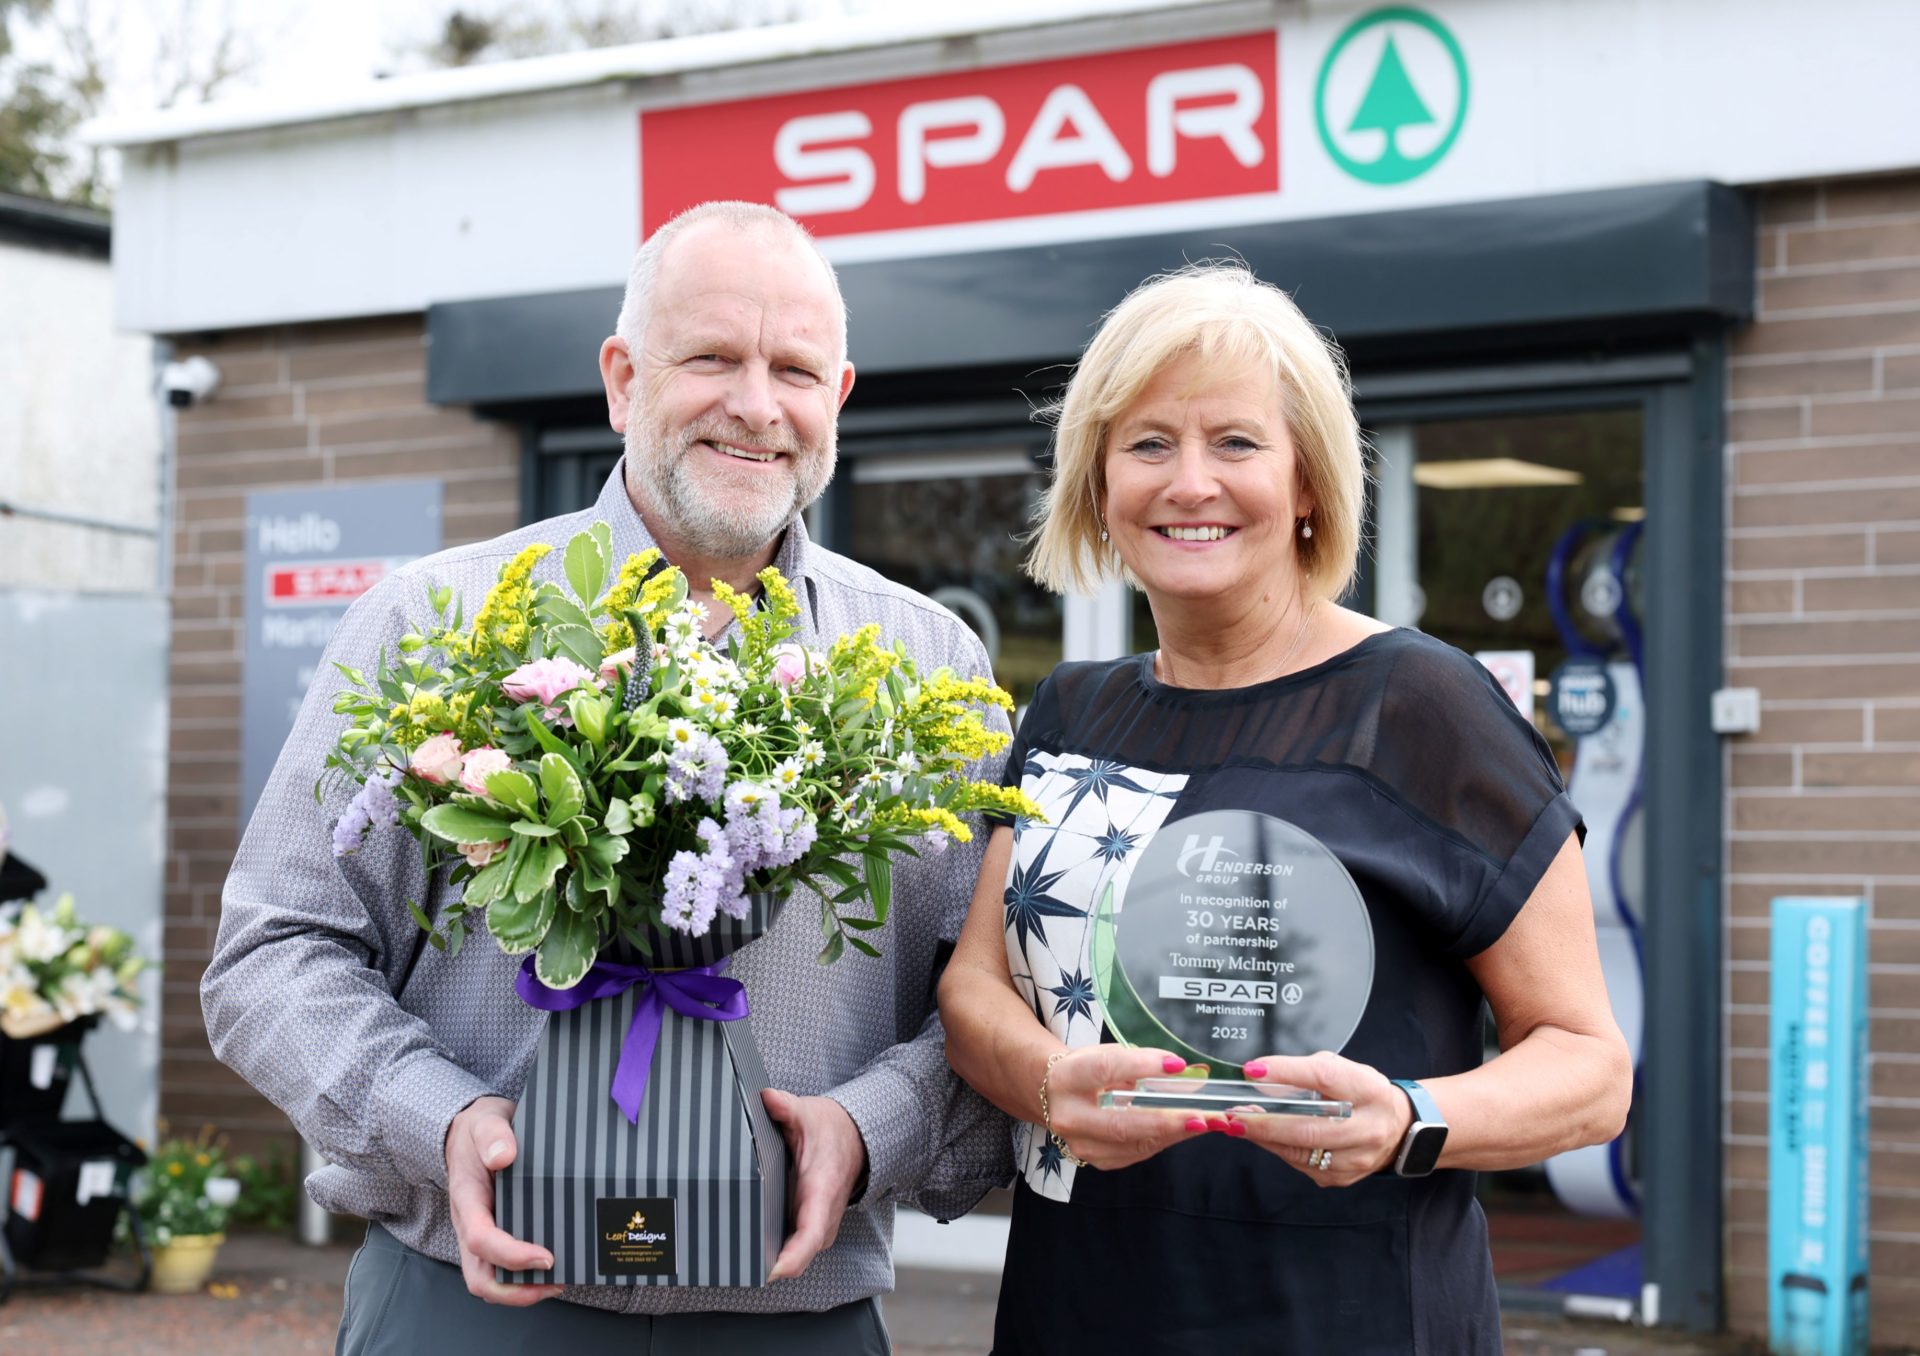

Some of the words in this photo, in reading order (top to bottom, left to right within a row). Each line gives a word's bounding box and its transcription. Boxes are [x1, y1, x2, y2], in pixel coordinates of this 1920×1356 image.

[773, 62, 1265, 216] SPAR
[258, 513, 341, 551] Hello
[1176, 834, 1294, 877] HENDERSON
[1196, 874, 1239, 885] GROUP
[1180, 893, 1192, 905] In
[1196, 895, 1270, 909] recognition
[1273, 898, 1288, 910] of
[1186, 910, 1214, 928] 30
[1220, 915, 1280, 932] YEARS
[1186, 933, 1201, 944] of
[1203, 935, 1278, 950] partnership
[1169, 952, 1225, 973] Tommy
[1228, 955, 1295, 976] McIntyre
[1184, 981, 1274, 1001] SPAR
[1195, 1003, 1265, 1017] Martinstown
[1211, 1026, 1248, 1040] 2023
[606, 1230, 627, 1243] Leaf
[628, 1230, 667, 1244] Designs
